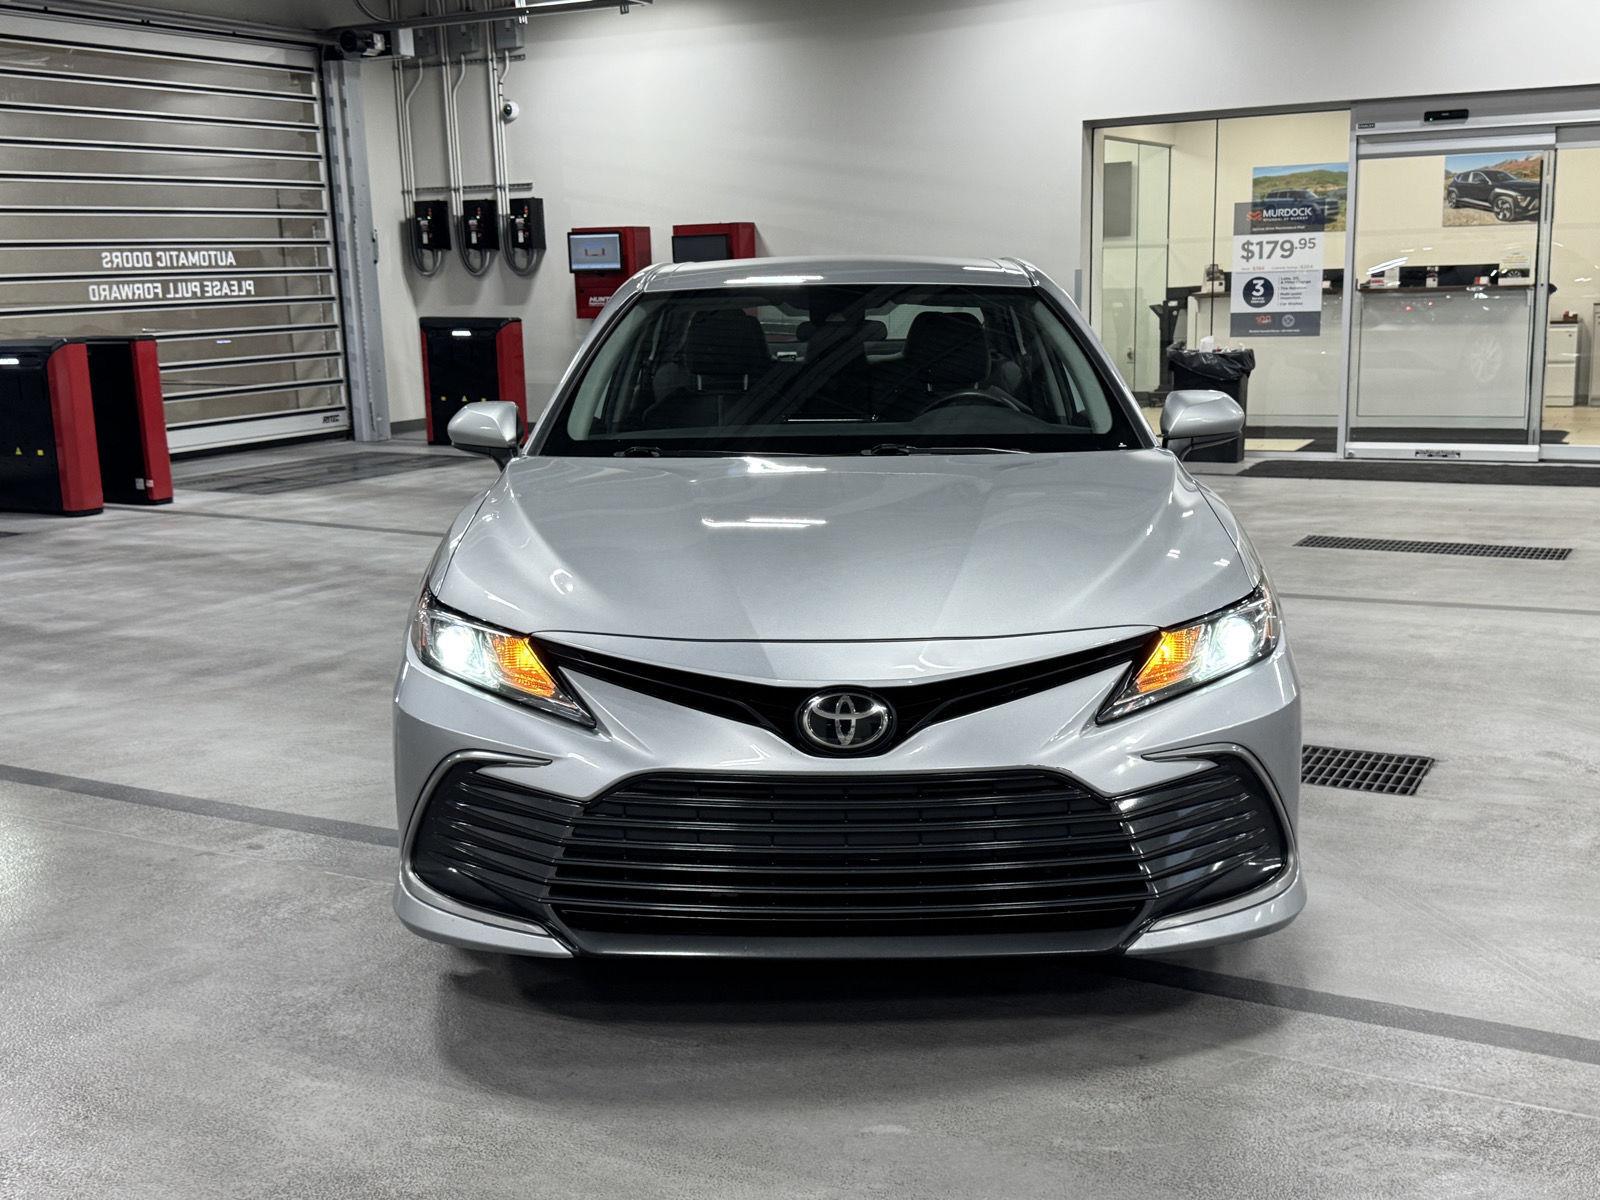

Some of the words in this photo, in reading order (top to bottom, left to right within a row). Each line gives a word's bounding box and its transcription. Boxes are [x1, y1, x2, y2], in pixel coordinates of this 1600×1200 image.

[1263, 207, 1313, 218] MURDOCK
[1240, 237, 1316, 262] $179.95
[1251, 279, 1265, 297] 3
